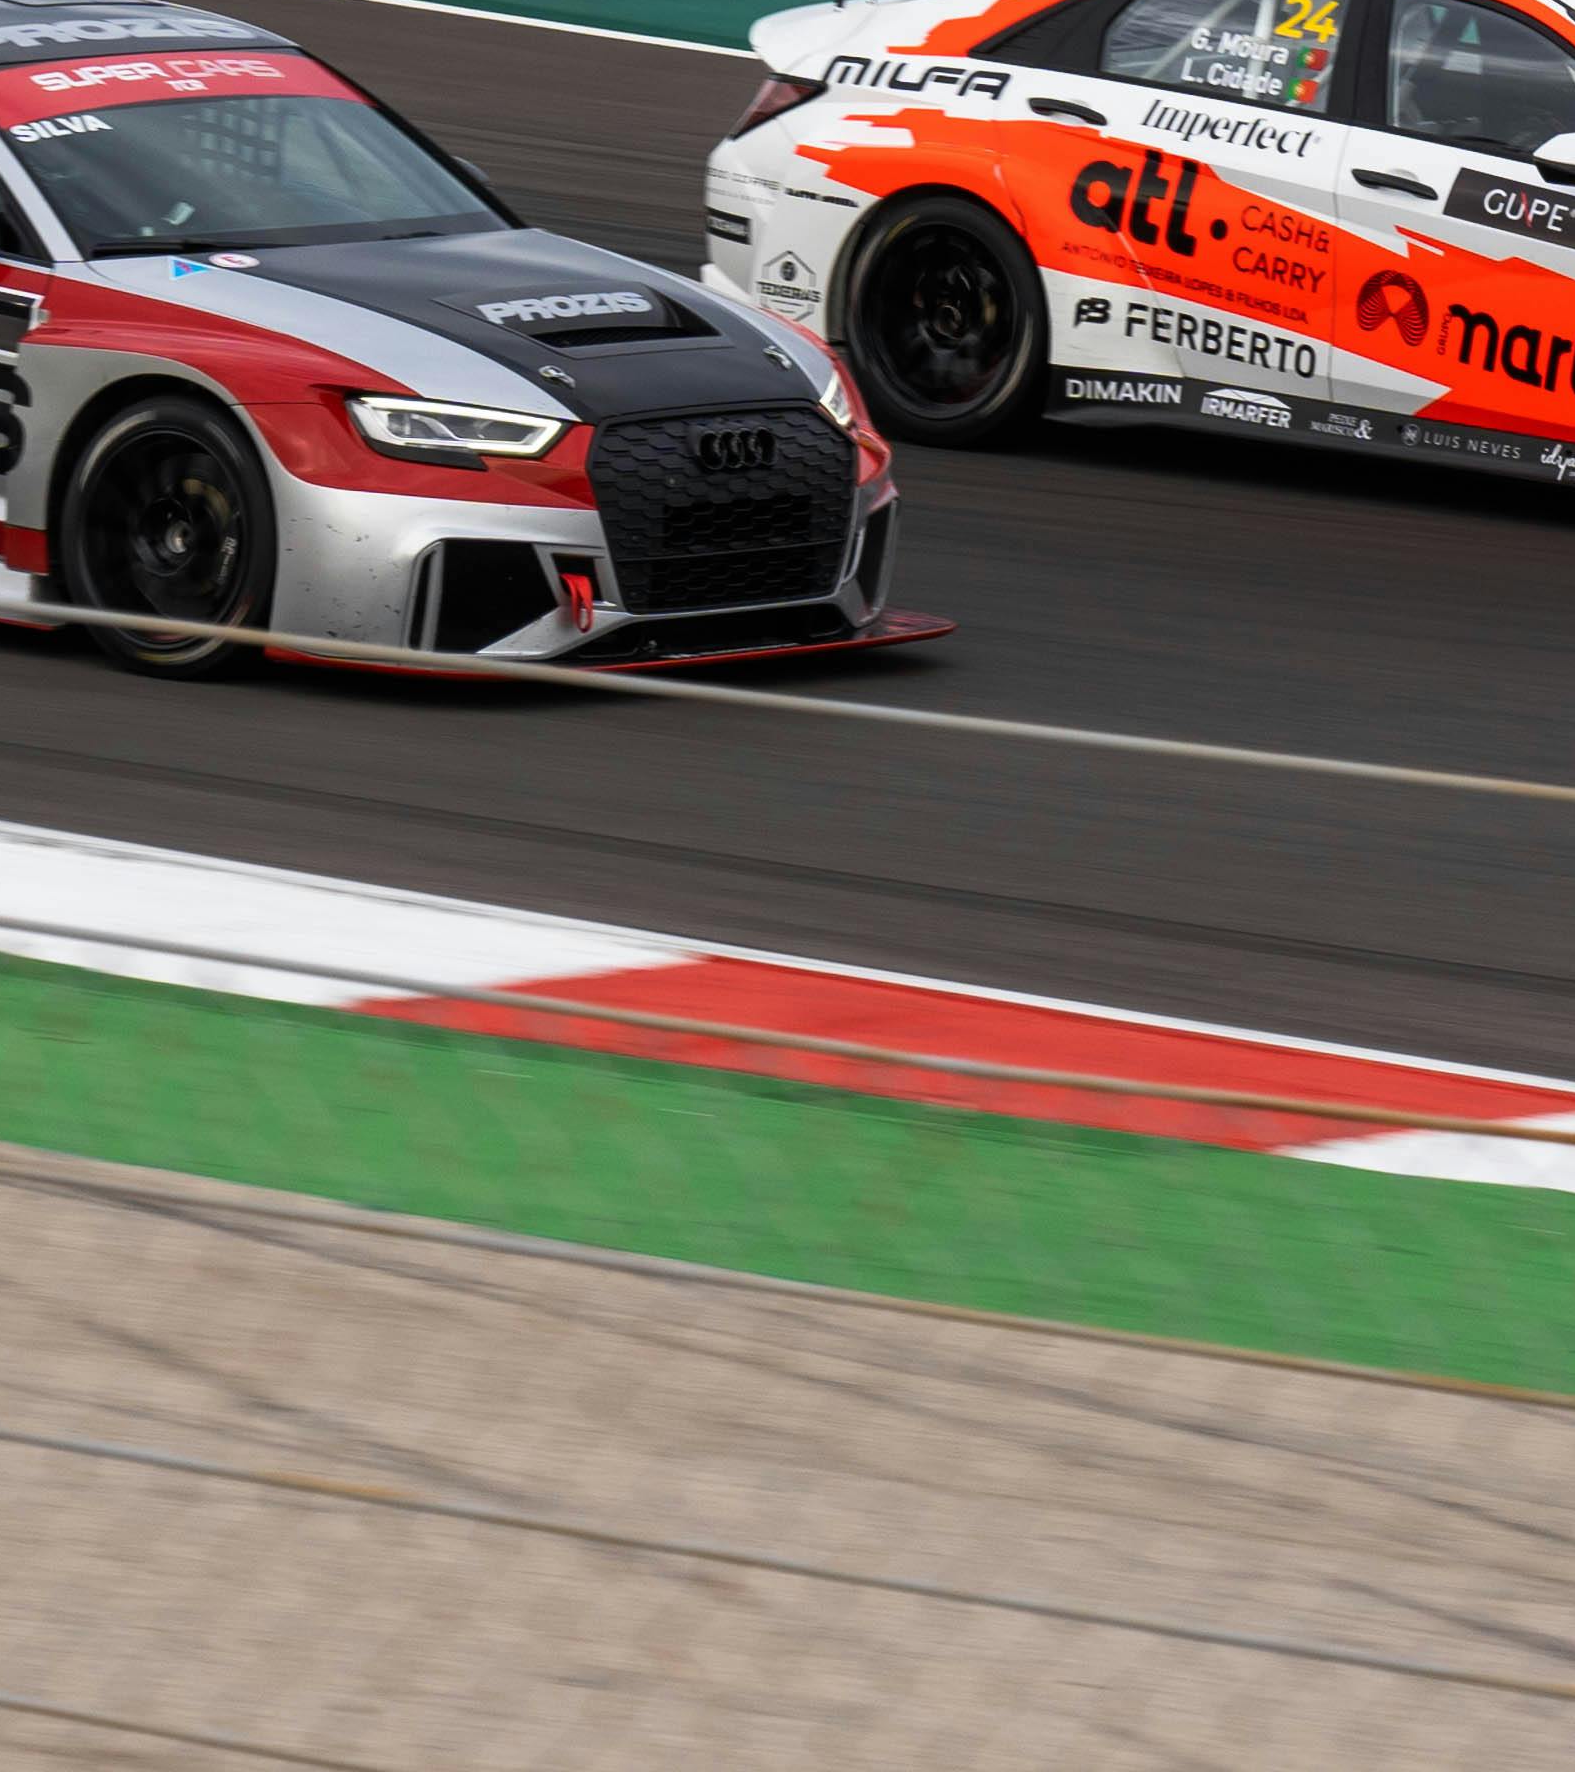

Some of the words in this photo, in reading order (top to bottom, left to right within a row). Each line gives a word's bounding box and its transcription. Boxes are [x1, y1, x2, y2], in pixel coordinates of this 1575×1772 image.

[1191, 27, 1214, 52] G.
[1218, 31, 1290, 66] Moura
[30, 62, 169, 92] SUPER
[164, 59, 287, 79] CARS
[1180, 56, 1204, 84] L.
[1207, 62, 1284, 96] Cidade
[9, 114, 114, 143] SILVA
[1140, 99, 1315, 157] Imperfect
[1232, 246, 1326, 294] CARRY
[475, 291, 653, 326] PROZIS
[1125, 302, 1316, 379] FERBERTO
[1065, 378, 1182, 404] DIMAKIN
[1200, 395, 1291, 429] IRMARFER
[1424, 432, 1460, 449] LUIS
[1467, 439, 1521, 459] NEVES
